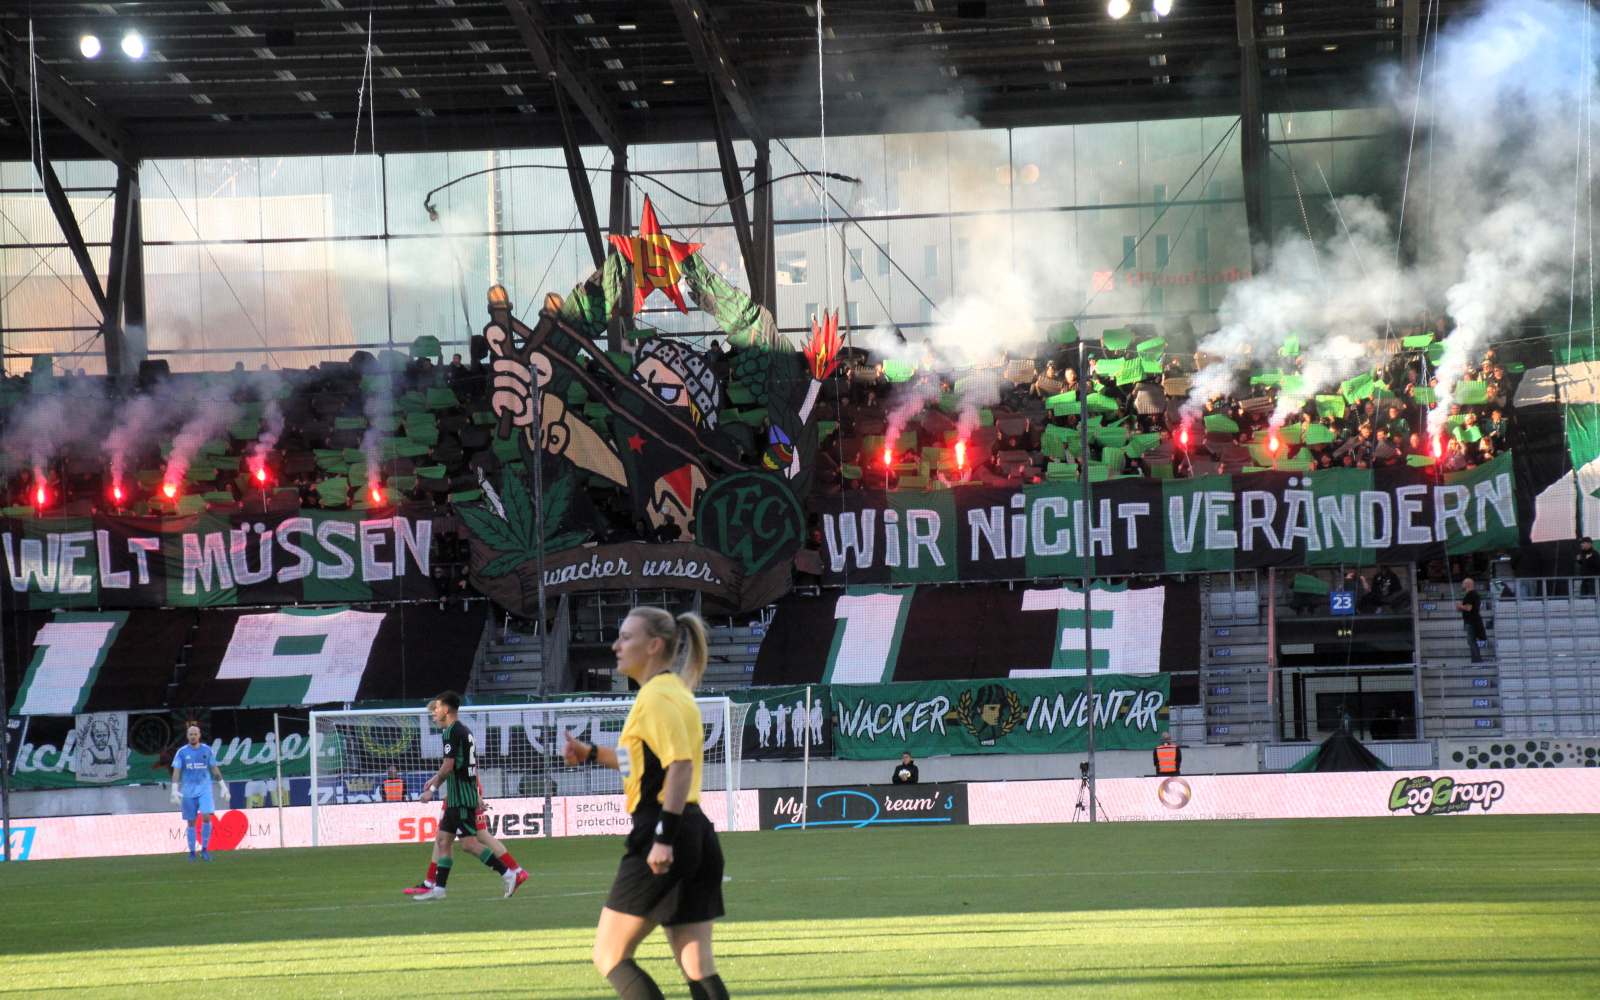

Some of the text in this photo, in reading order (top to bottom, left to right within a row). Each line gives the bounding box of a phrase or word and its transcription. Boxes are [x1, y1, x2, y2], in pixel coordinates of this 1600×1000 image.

[1167, 472, 1517, 554] VERÄNDERN
[2, 517, 432, 594] WELT MÜSSEN
[1333, 596, 1352, 610] 23
[837, 688, 1164, 743] WACKER INVENTAR
[576, 801, 620, 813] security
[1390, 777, 1504, 814] LogGroup
[576, 815, 633, 829] protection
[773, 796, 808, 824] My
[239, 822, 271, 838] ALM
